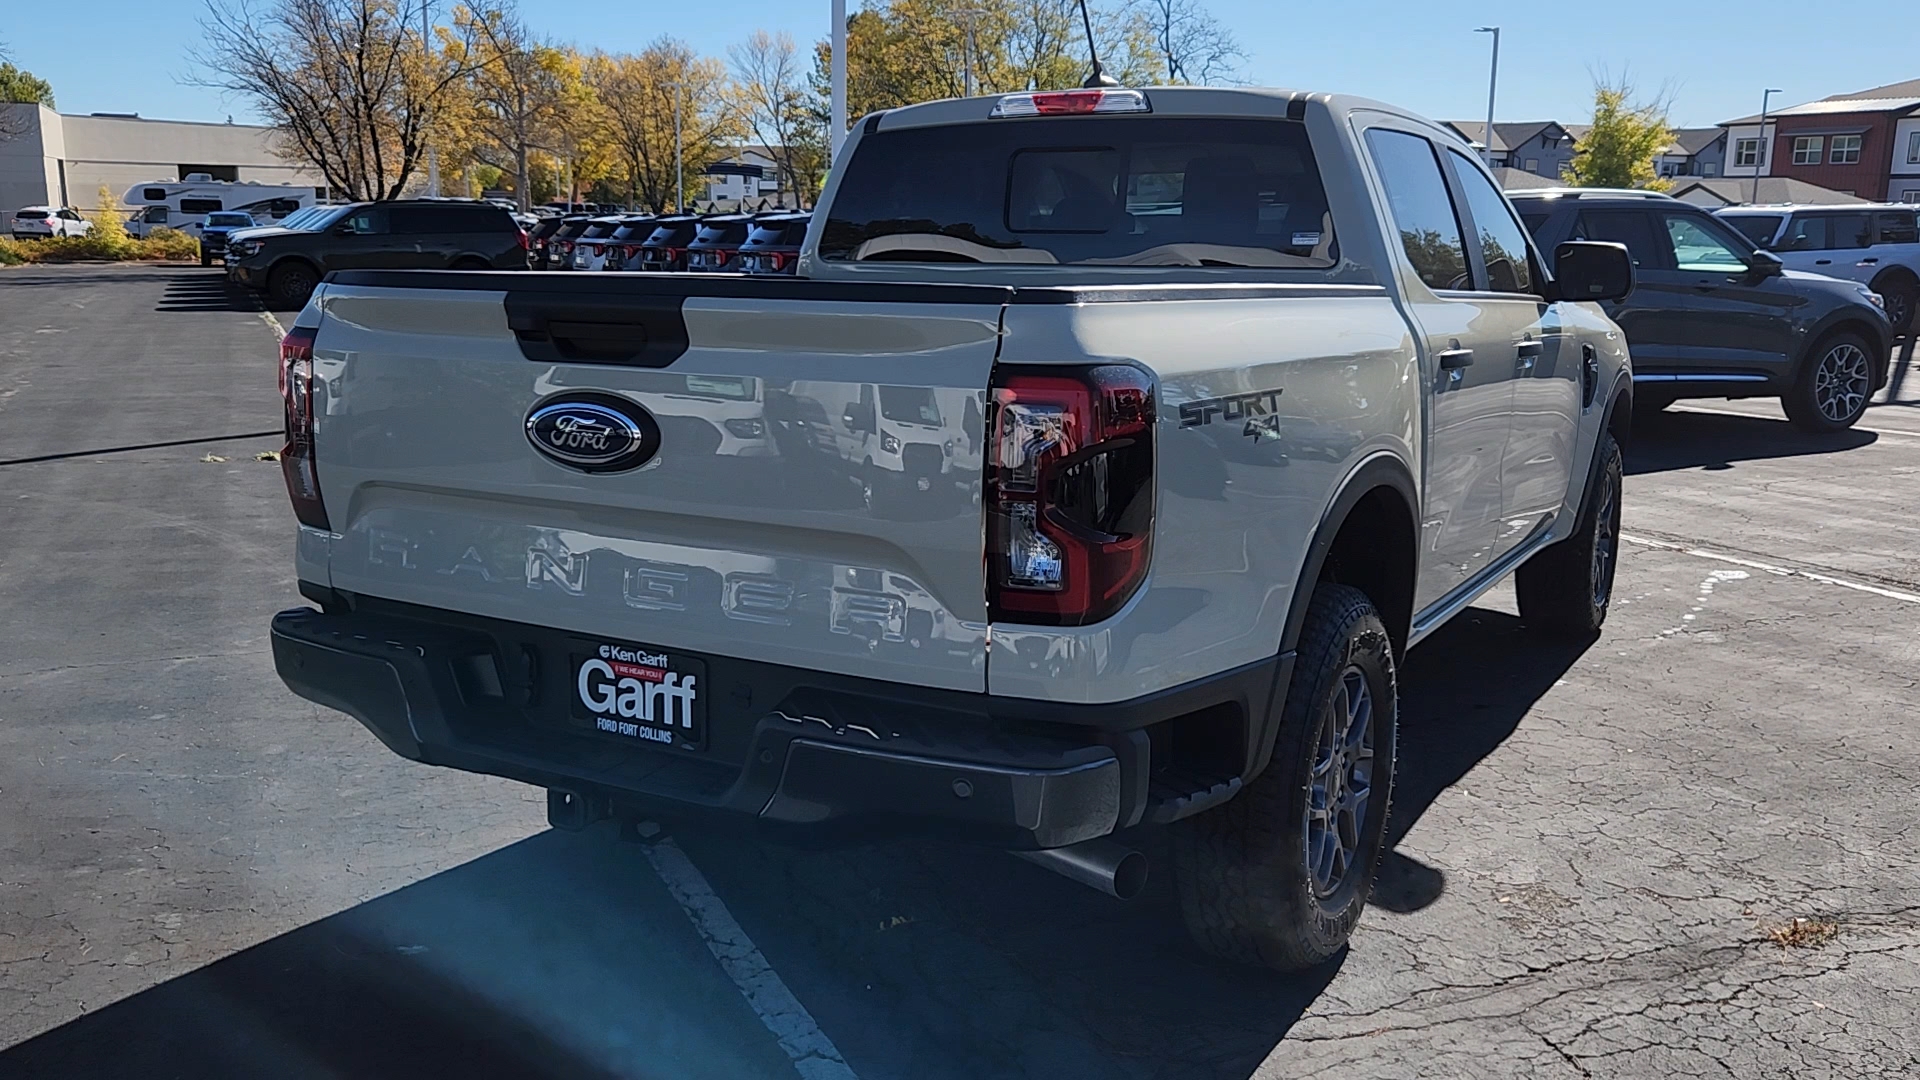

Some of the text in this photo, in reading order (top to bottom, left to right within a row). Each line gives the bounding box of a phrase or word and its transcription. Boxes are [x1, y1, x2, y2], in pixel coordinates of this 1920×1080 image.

[1179, 386, 1284, 429] SPORT
[551, 415, 610, 450] Ford
[368, 526, 908, 643] RANGER
[611, 646, 668, 668] Ken Garff
[619, 666, 658, 678] WE HEAR YOU
[578, 658, 696, 728] Garff
[597, 717, 672, 743] FORD FORT COLLINS
